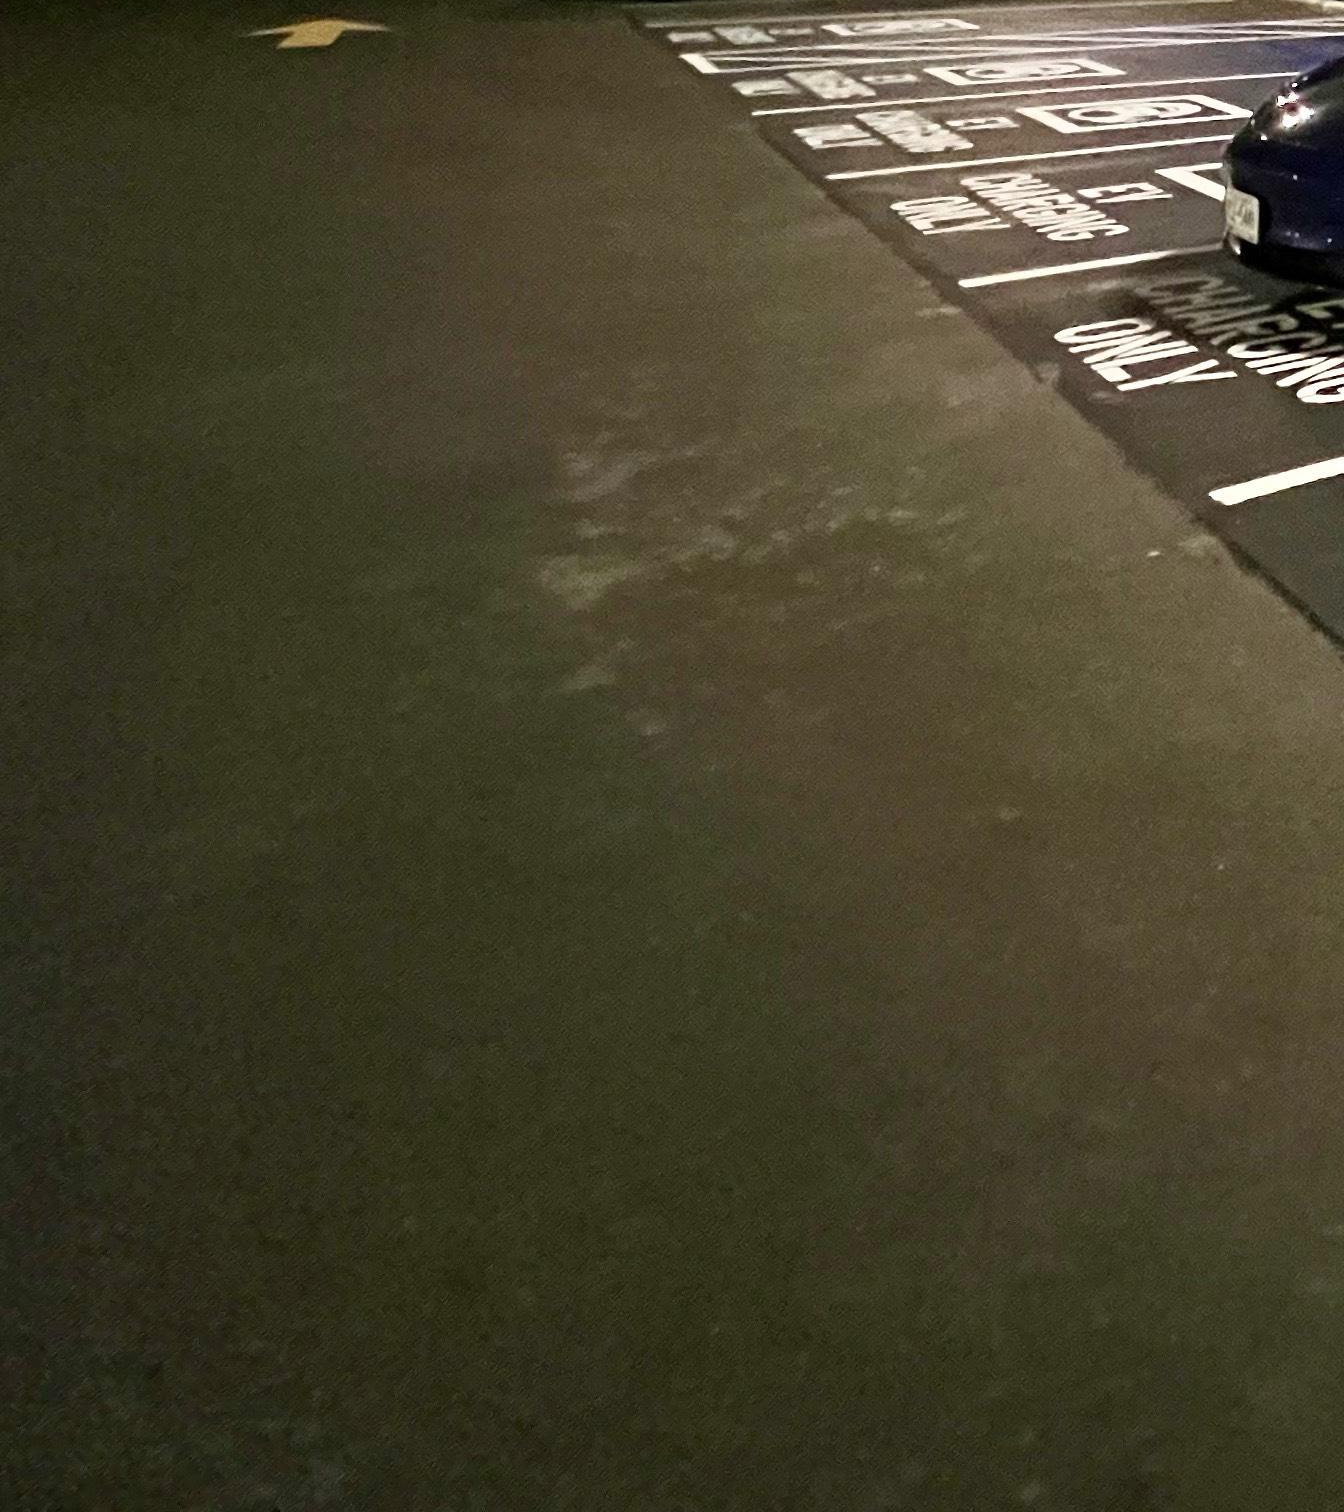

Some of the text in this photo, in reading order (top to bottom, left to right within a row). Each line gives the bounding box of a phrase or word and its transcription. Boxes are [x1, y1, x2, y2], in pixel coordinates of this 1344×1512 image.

[889, 196, 1011, 235] ONLY
[959, 172, 1130, 241] CHARGING
[1077, 182, 1174, 204] EV
[1053, 317, 1238, 392] ONLY
